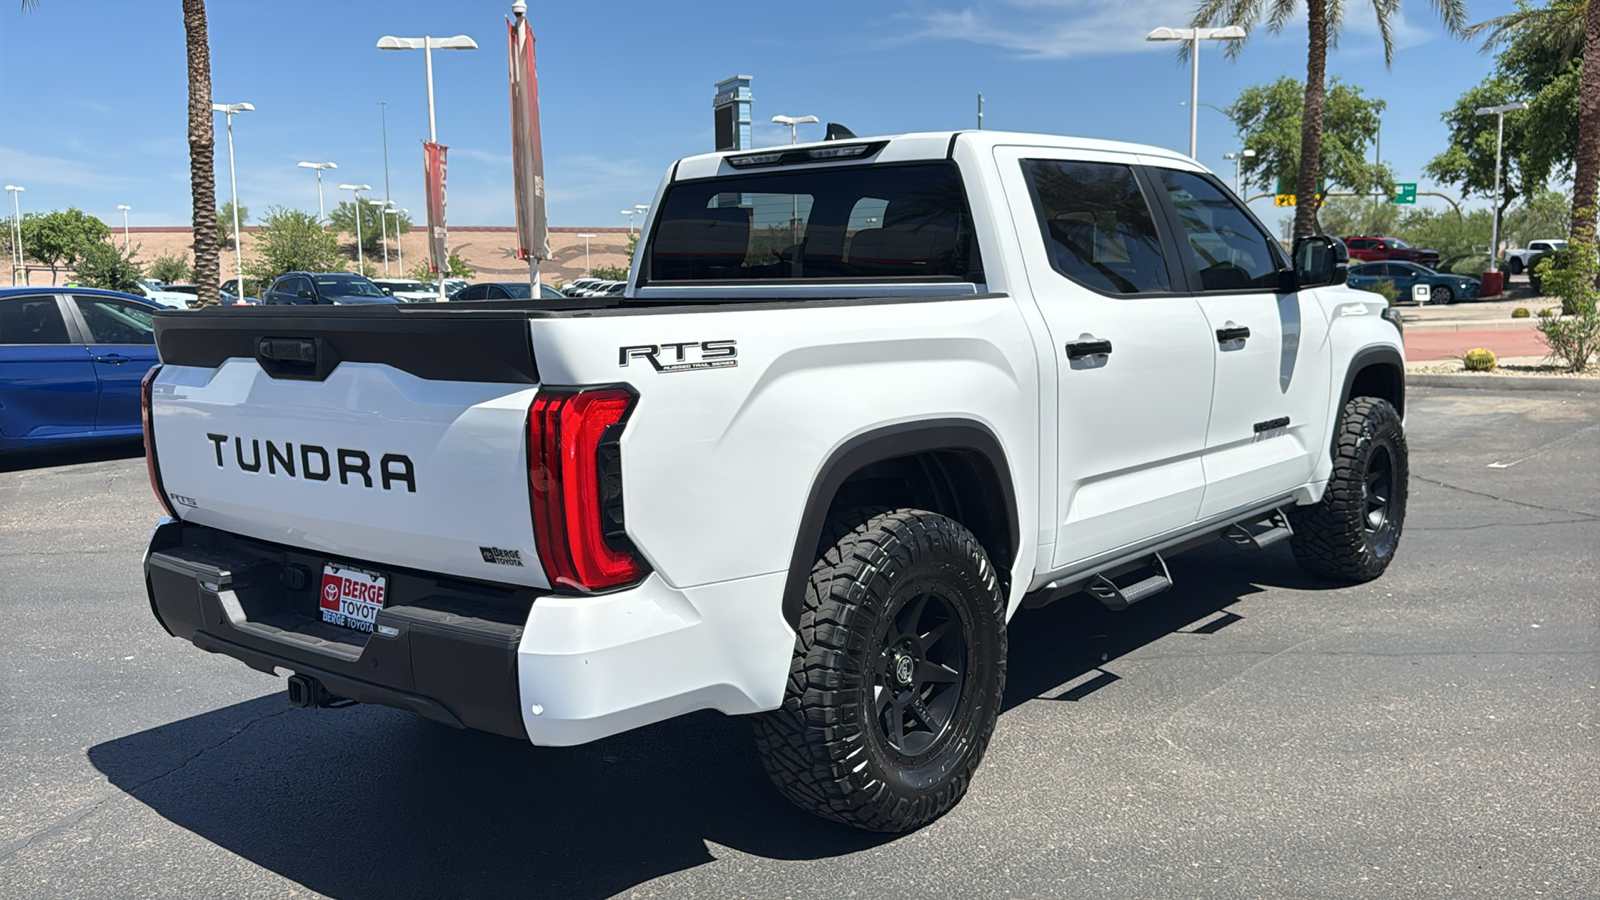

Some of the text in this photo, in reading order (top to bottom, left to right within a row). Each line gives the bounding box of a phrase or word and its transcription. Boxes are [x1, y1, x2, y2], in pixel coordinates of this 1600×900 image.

[618, 339, 738, 374] RTS
[206, 432, 417, 493] TUNDRA
[170, 493, 198, 509] RTS
[492, 547, 520, 559] BERGE
[496, 558, 523, 566] TOYOTA
[343, 578, 384, 604] BERGE
[322, 610, 374, 633] BERGE TOYOTA
